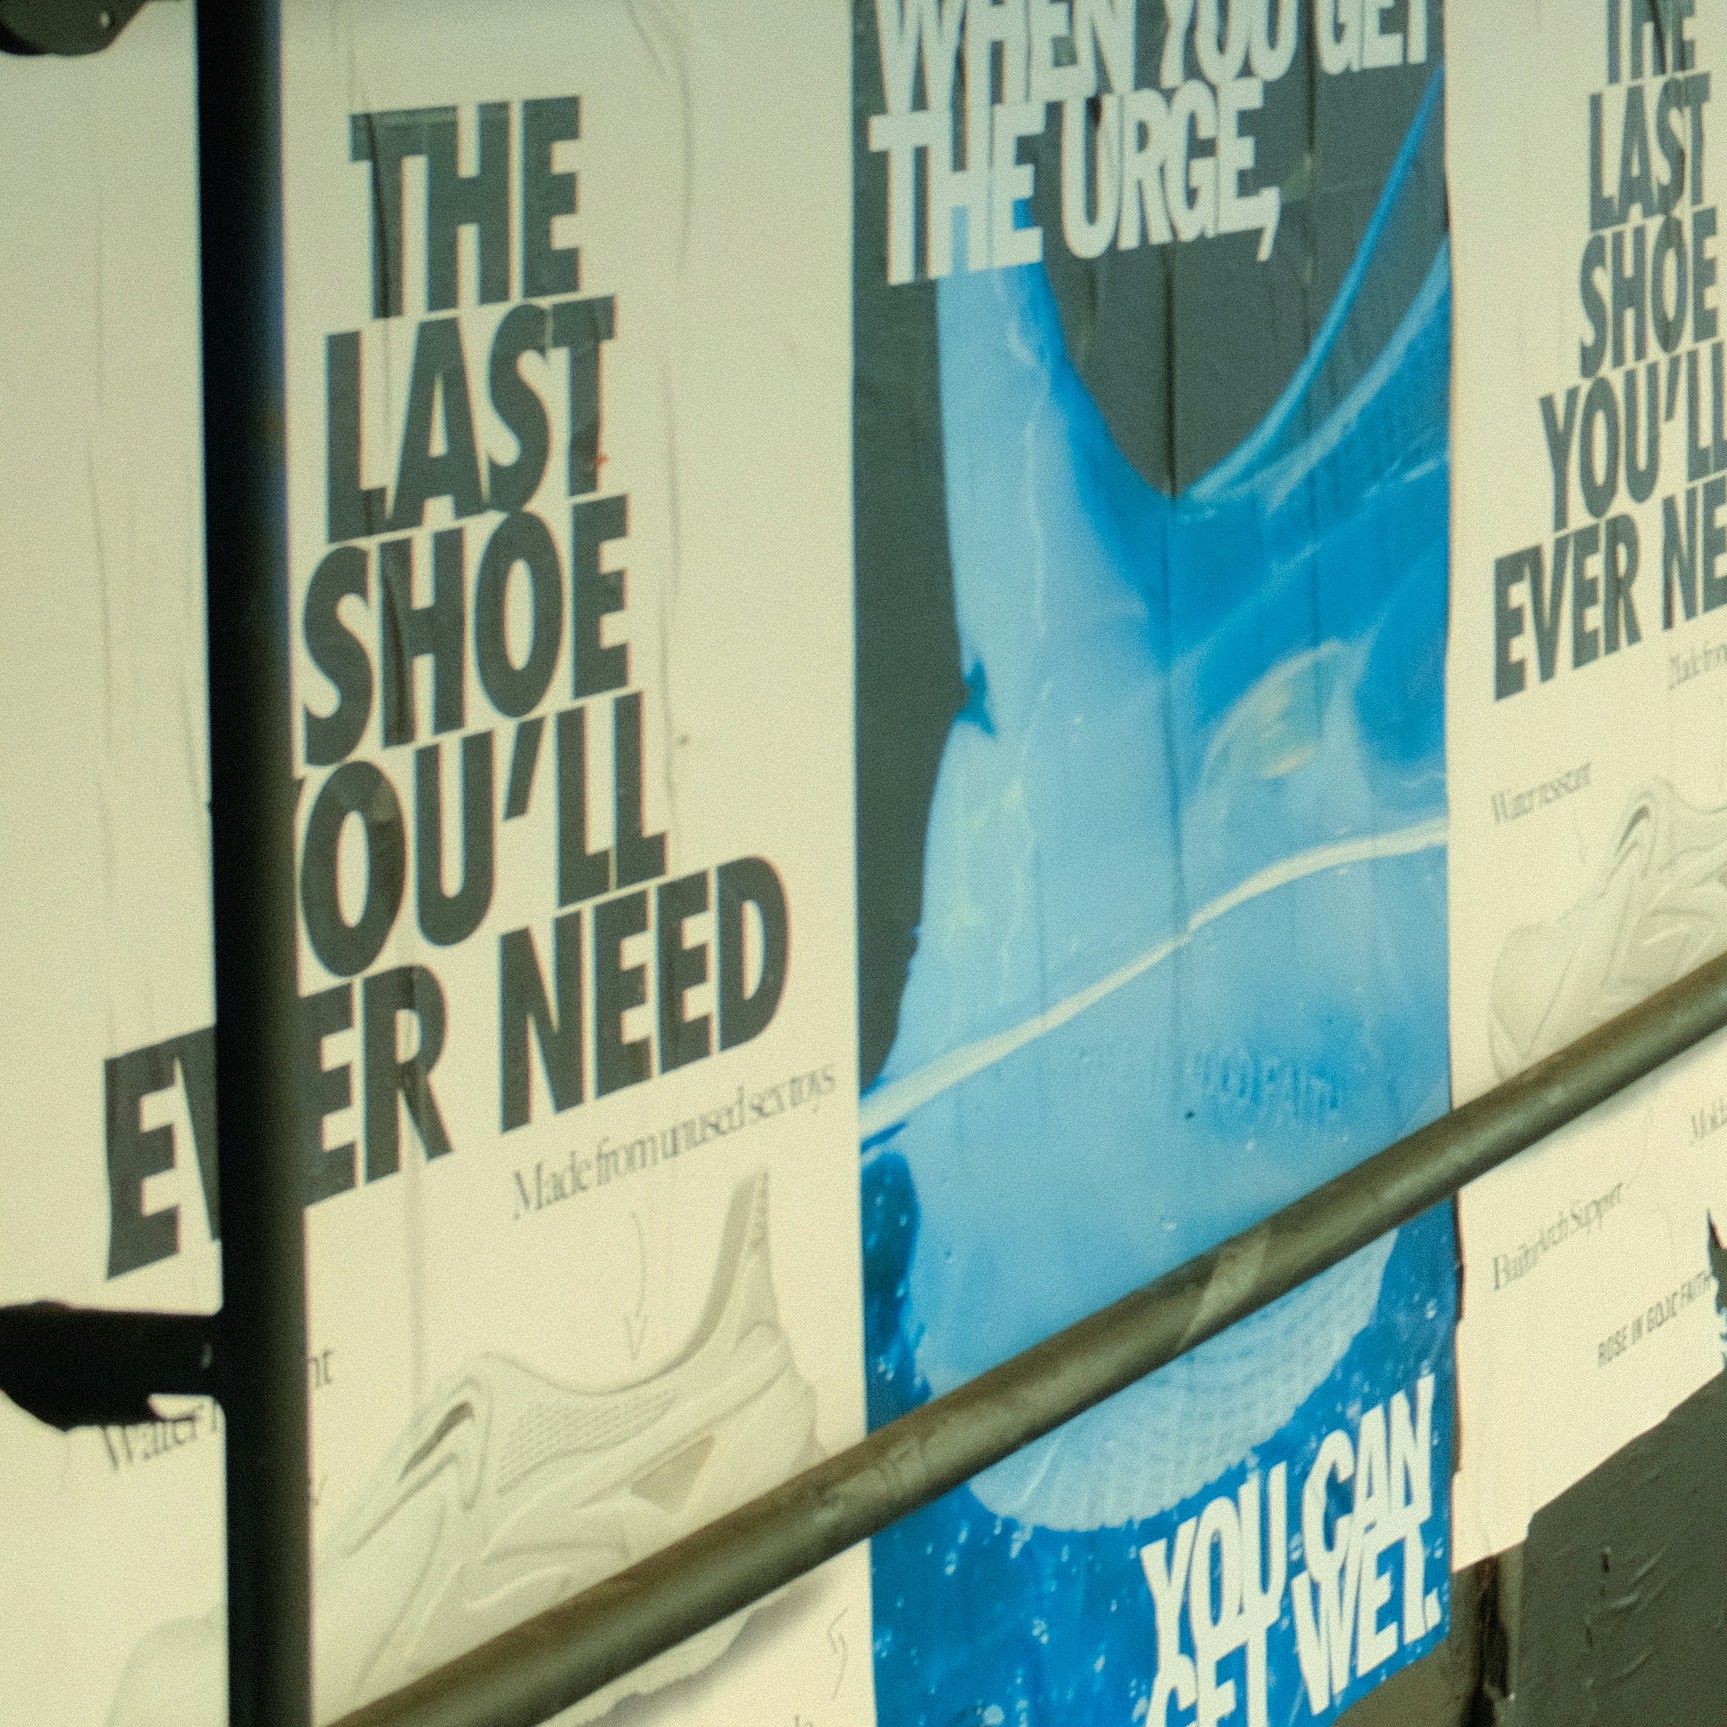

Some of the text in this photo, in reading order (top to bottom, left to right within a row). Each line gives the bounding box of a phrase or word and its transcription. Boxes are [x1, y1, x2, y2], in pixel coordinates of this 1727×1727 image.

[349, 95, 582, 320] THE
[868, 77, 1280, 286] THE URGE,
[1588, 70, 1711, 233] LAST
[1579, 205, 1718, 380] SHOE
[325, 293, 616, 545] LAST
[302, 494, 629, 767] SHOE
[1493, 512, 1642, 703] EVER
[297, 690, 669, 980] OU'LL
[500, 855, 792, 1134] NEED
[513, 1149, 592, 1221] Made
[595, 1135, 660, 1186] from
[661, 1084, 746, 1160] unused
[1138, 1373, 1434, 1660] YOU CAN
[1290, 1526, 1443, 1718] WET.
